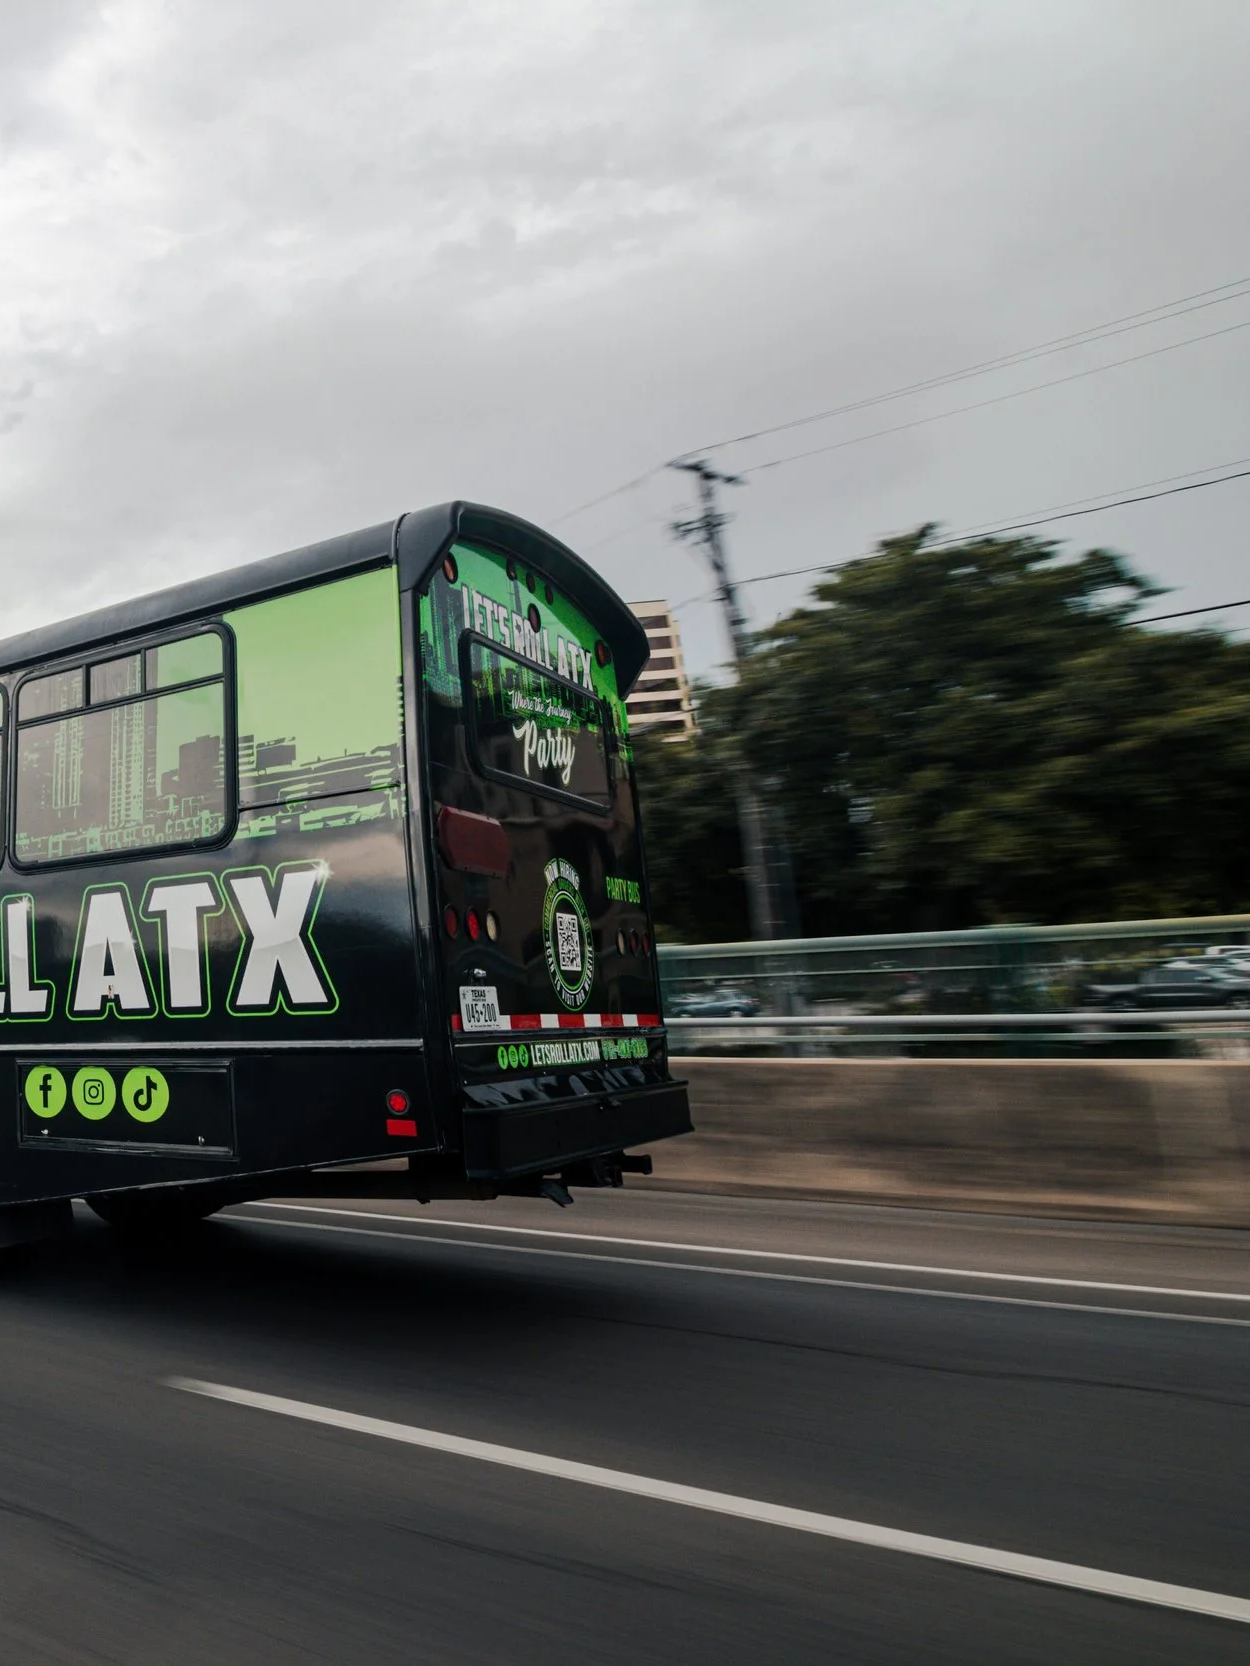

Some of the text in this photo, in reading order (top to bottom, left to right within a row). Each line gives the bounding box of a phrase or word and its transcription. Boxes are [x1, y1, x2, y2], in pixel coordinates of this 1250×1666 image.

[461, 583, 594, 693] LET'S ROLL ATX
[508, 689, 534, 711] Where
[512, 719, 576, 785] Party
[605, 875, 627, 902] PARTY
[627, 879, 641, 904] BUS
[69, 863, 335, 1019] ATX
[470, 989, 487, 998] TEXAS
[530, 1040, 601, 1066] LETSROLLATX.COM
